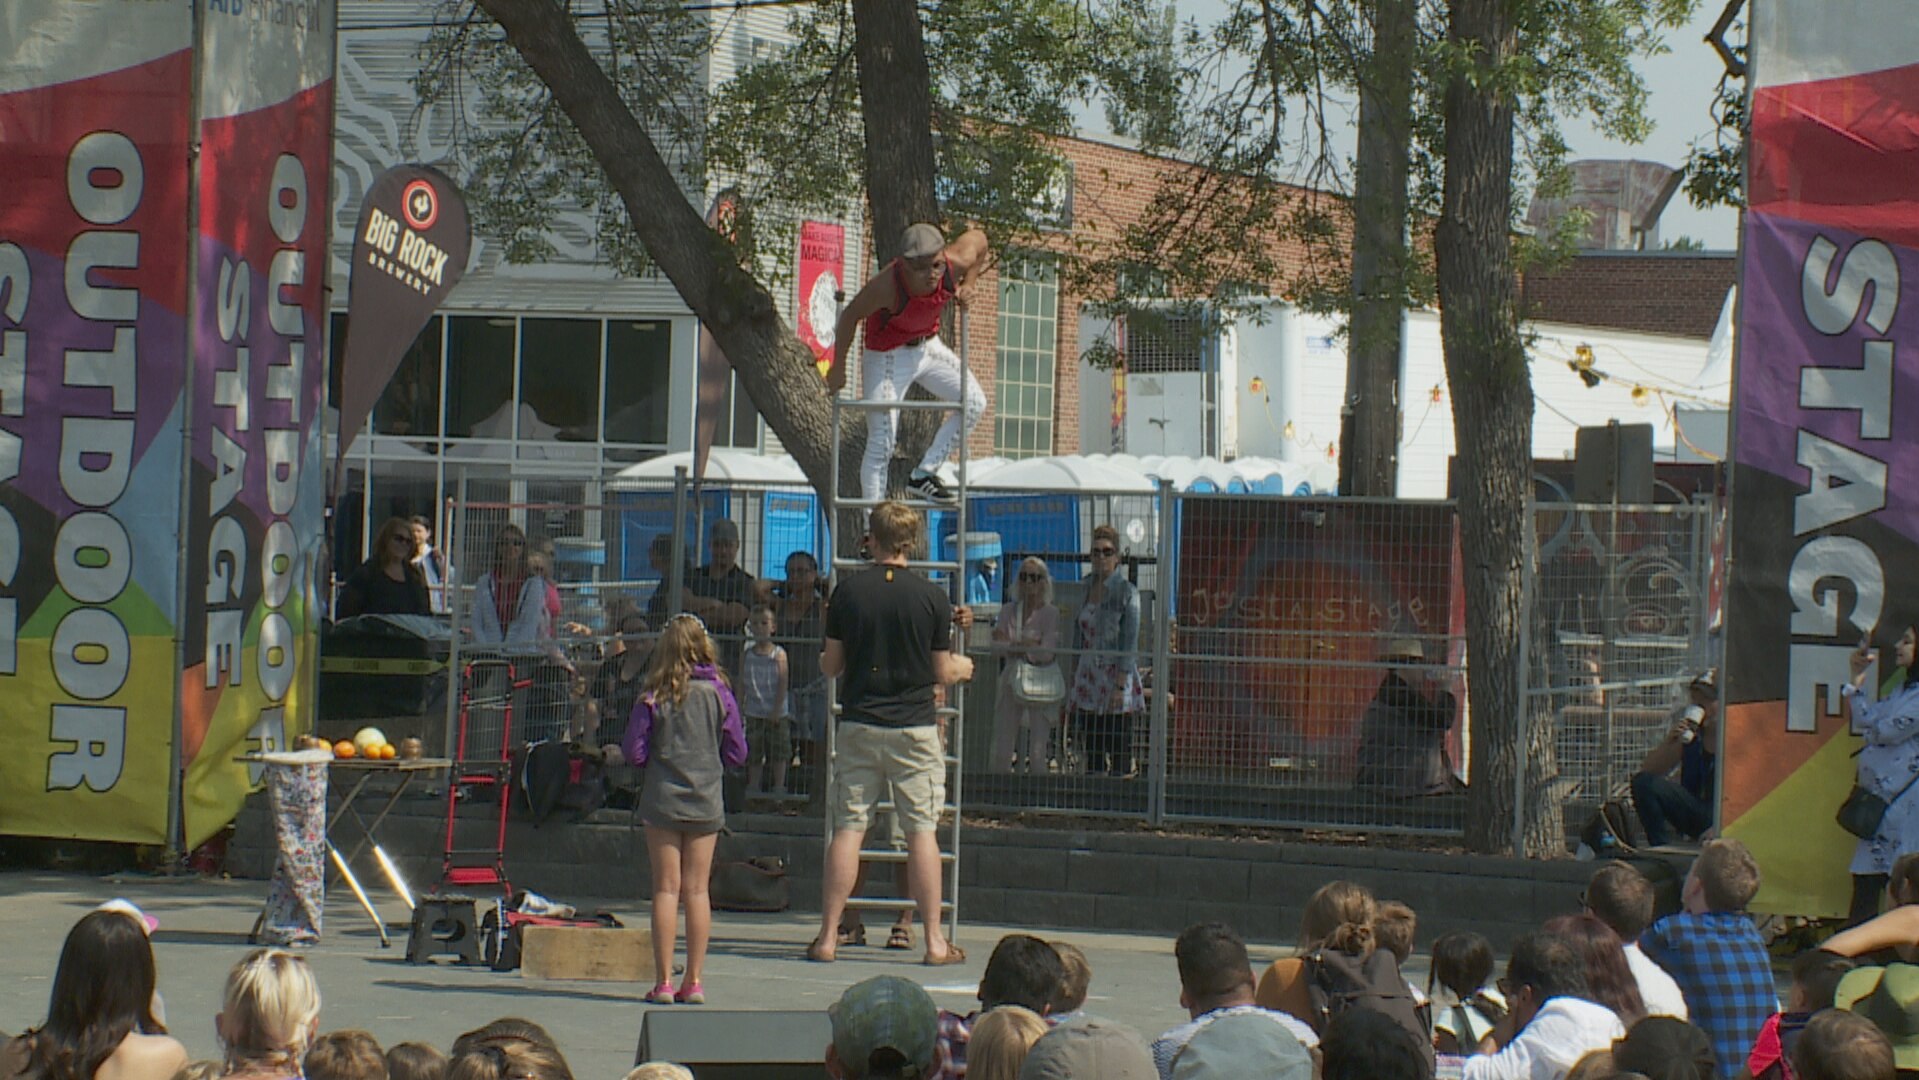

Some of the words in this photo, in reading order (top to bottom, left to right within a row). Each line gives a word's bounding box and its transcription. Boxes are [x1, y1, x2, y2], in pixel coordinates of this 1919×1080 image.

[46, 130, 144, 793] OUTDOOR
[205, 255, 250, 690] STAGE
[368, 251, 430, 296] BREWERY
[398, 228, 449, 286] ROCK
[1786, 232, 1901, 738] STAGE
